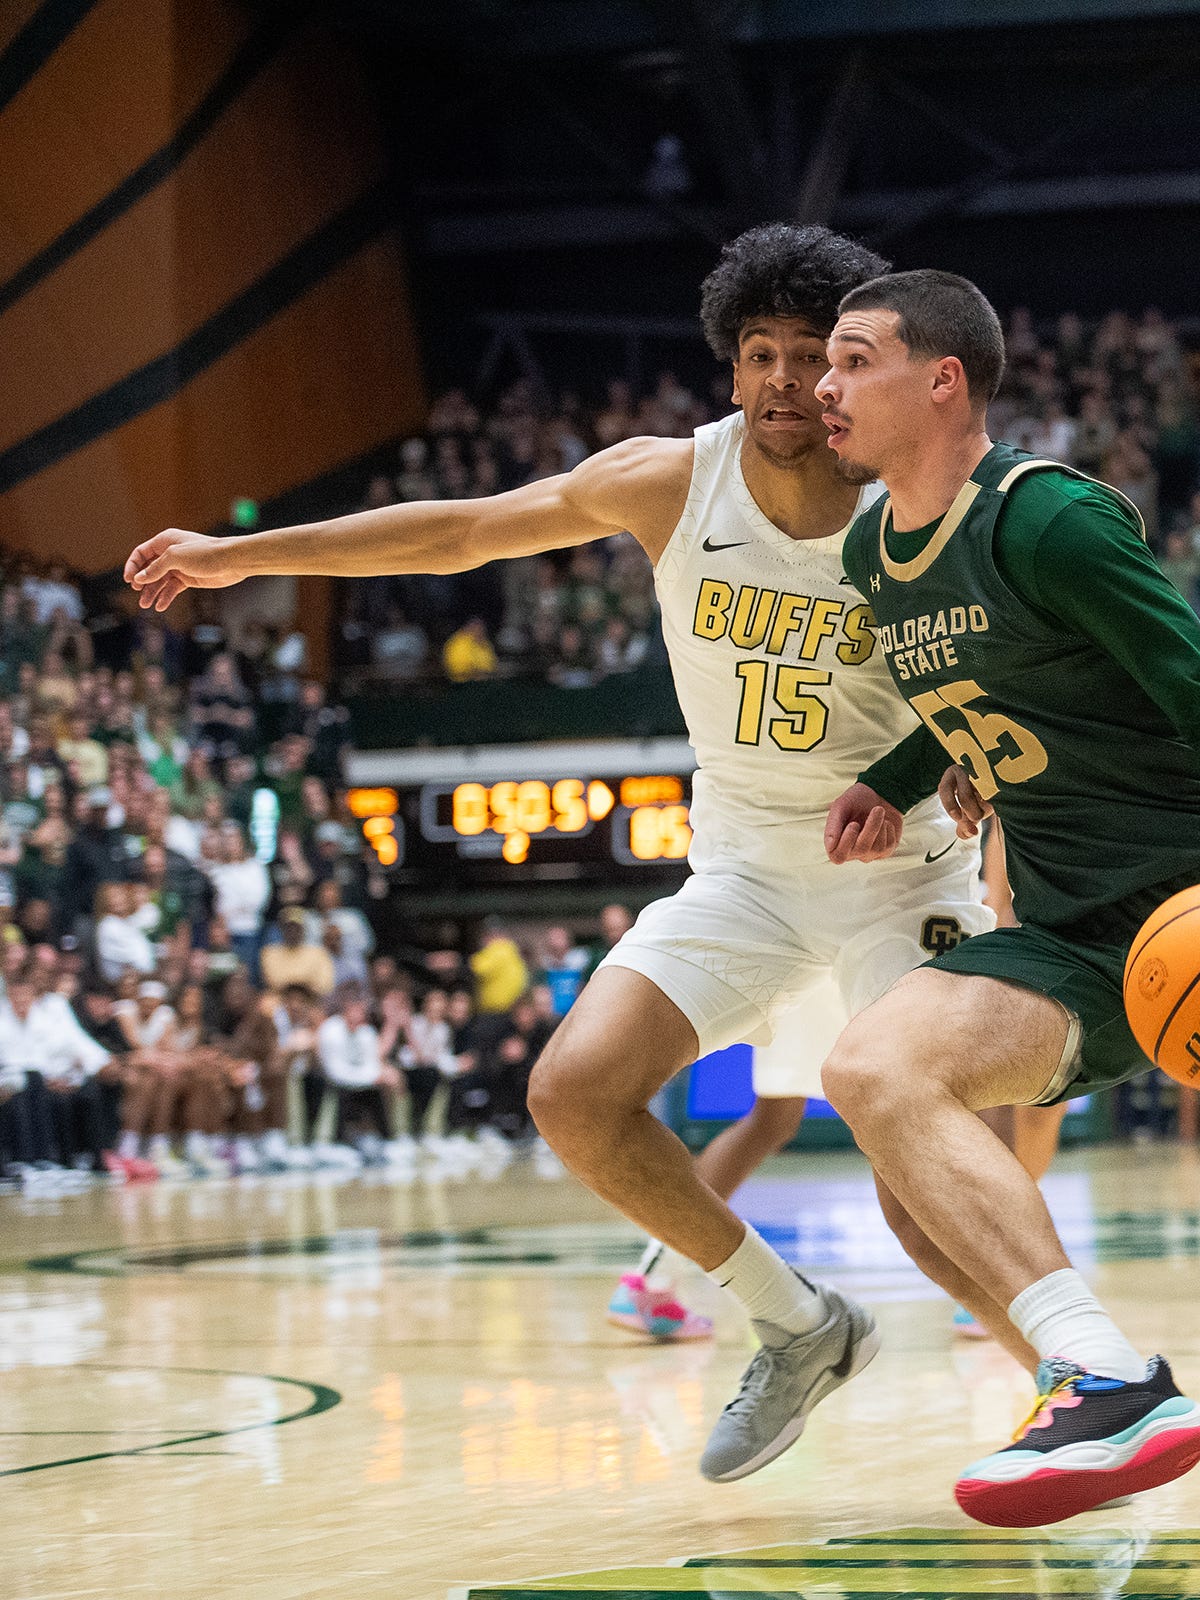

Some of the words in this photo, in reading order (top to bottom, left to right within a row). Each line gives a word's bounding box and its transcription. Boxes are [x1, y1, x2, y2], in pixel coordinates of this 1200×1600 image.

[692, 577, 877, 666] BUFFS
[878, 604, 989, 656] OLORADO
[894, 638, 959, 680] STATE
[735, 659, 832, 752] 15
[909, 680, 1048, 800] 55
